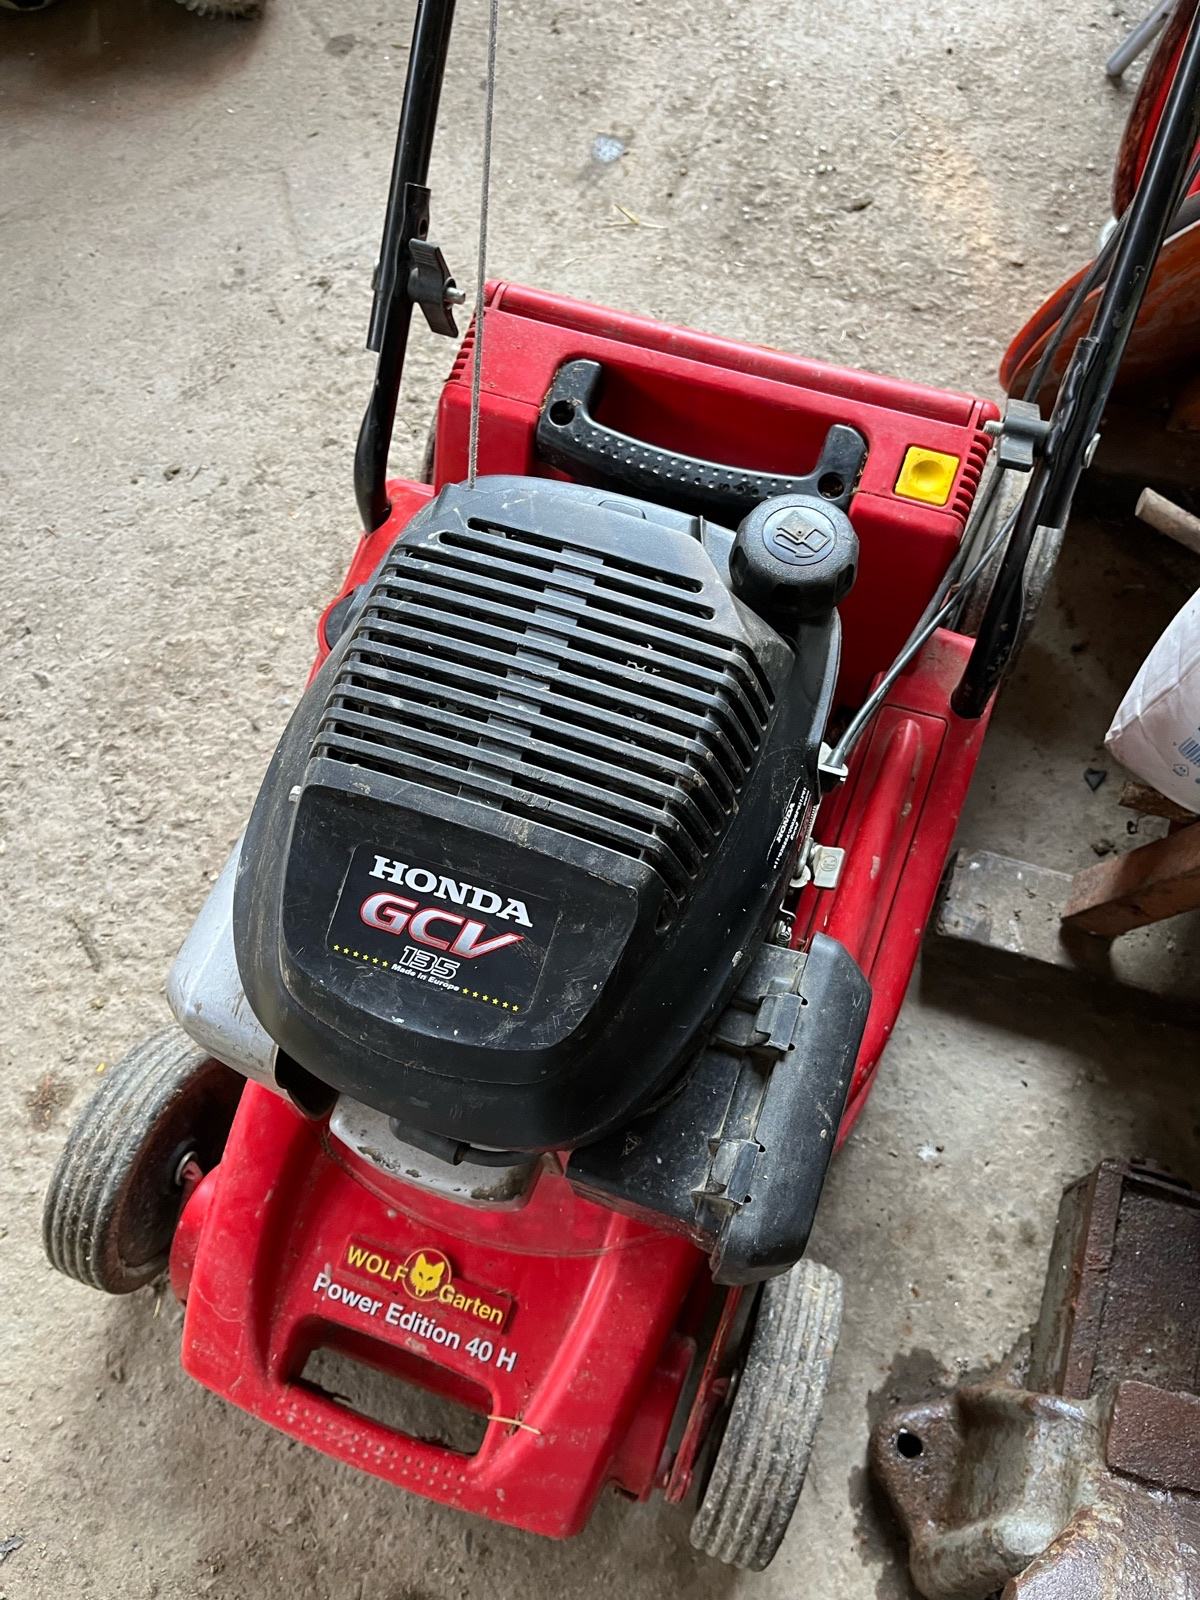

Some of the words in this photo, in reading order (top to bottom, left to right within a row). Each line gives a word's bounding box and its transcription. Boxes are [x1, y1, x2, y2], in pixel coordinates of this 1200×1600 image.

[359, 891, 525, 959] GCV
[368, 855, 533, 928] HONDA
[391, 963, 416, 977] Made
[428, 975, 460, 992] Europe
[399, 945, 461, 980] 135
[347, 1246, 409, 1283] WOLF
[438, 1284, 504, 1325] Garten
[312, 1272, 383, 1316] Power
[385, 1302, 461, 1350] Edition
[464, 1337, 493, 1362] 40
[495, 1347, 518, 1372] H
